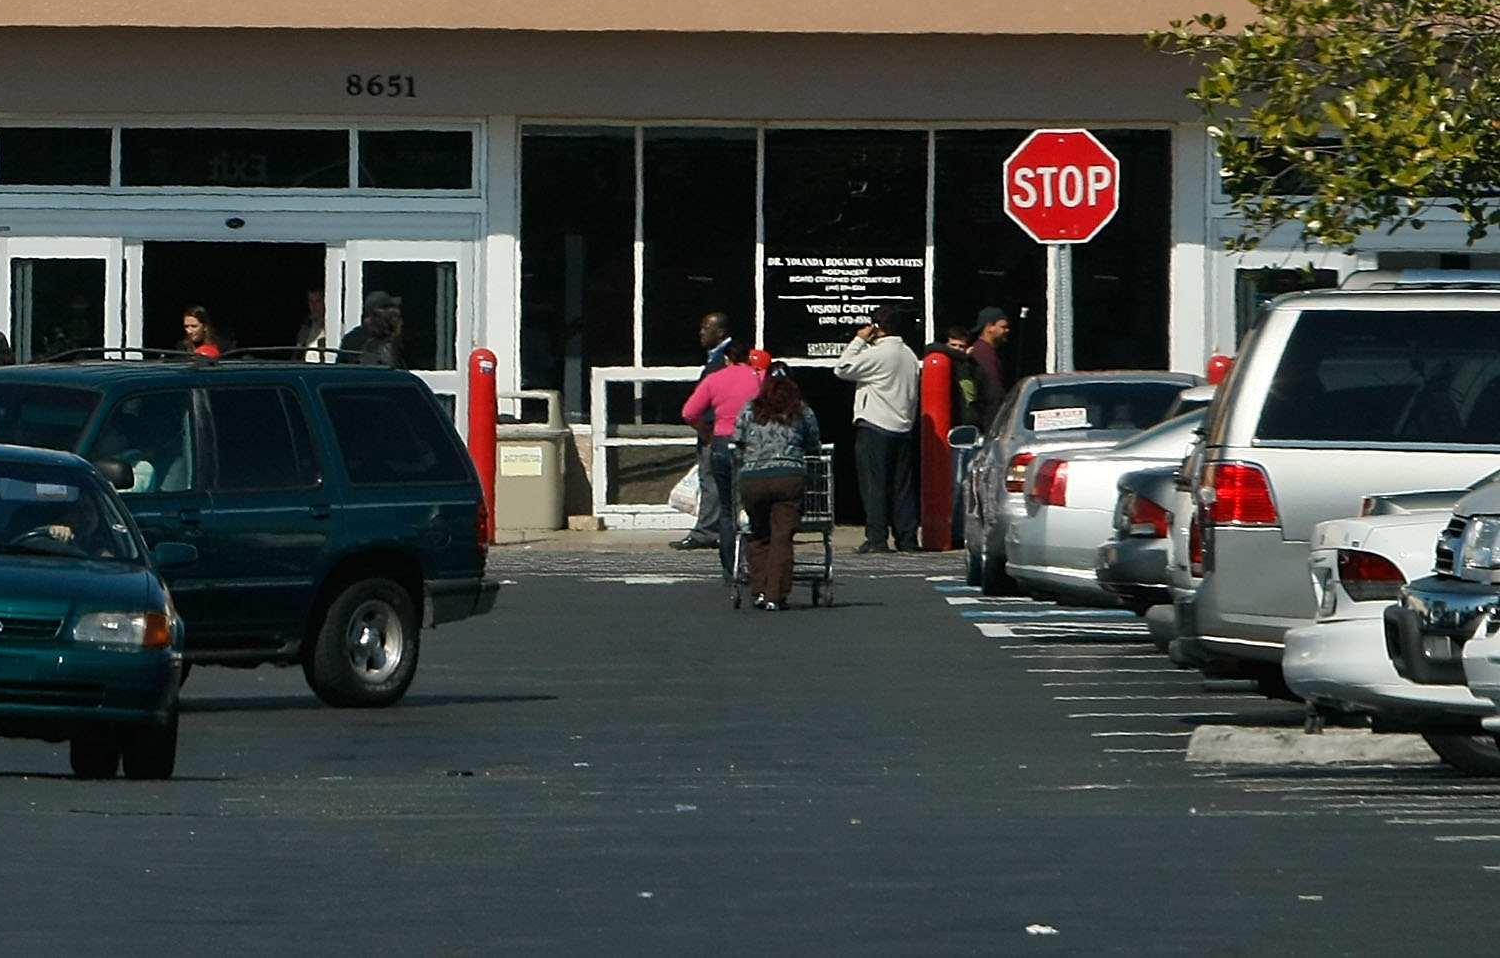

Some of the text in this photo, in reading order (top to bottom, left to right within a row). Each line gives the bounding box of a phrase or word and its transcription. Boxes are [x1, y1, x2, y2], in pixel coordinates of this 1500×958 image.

[346, 74, 417, 98] 8651
[1012, 165, 1112, 208] STOP
[767, 258, 784, 267] DR.
[785, 258, 825, 267] YOLANDA
[865, 258, 873, 267] &
[875, 258, 924, 267] ASSOCIATES
[806, 304, 841, 314] VISION
